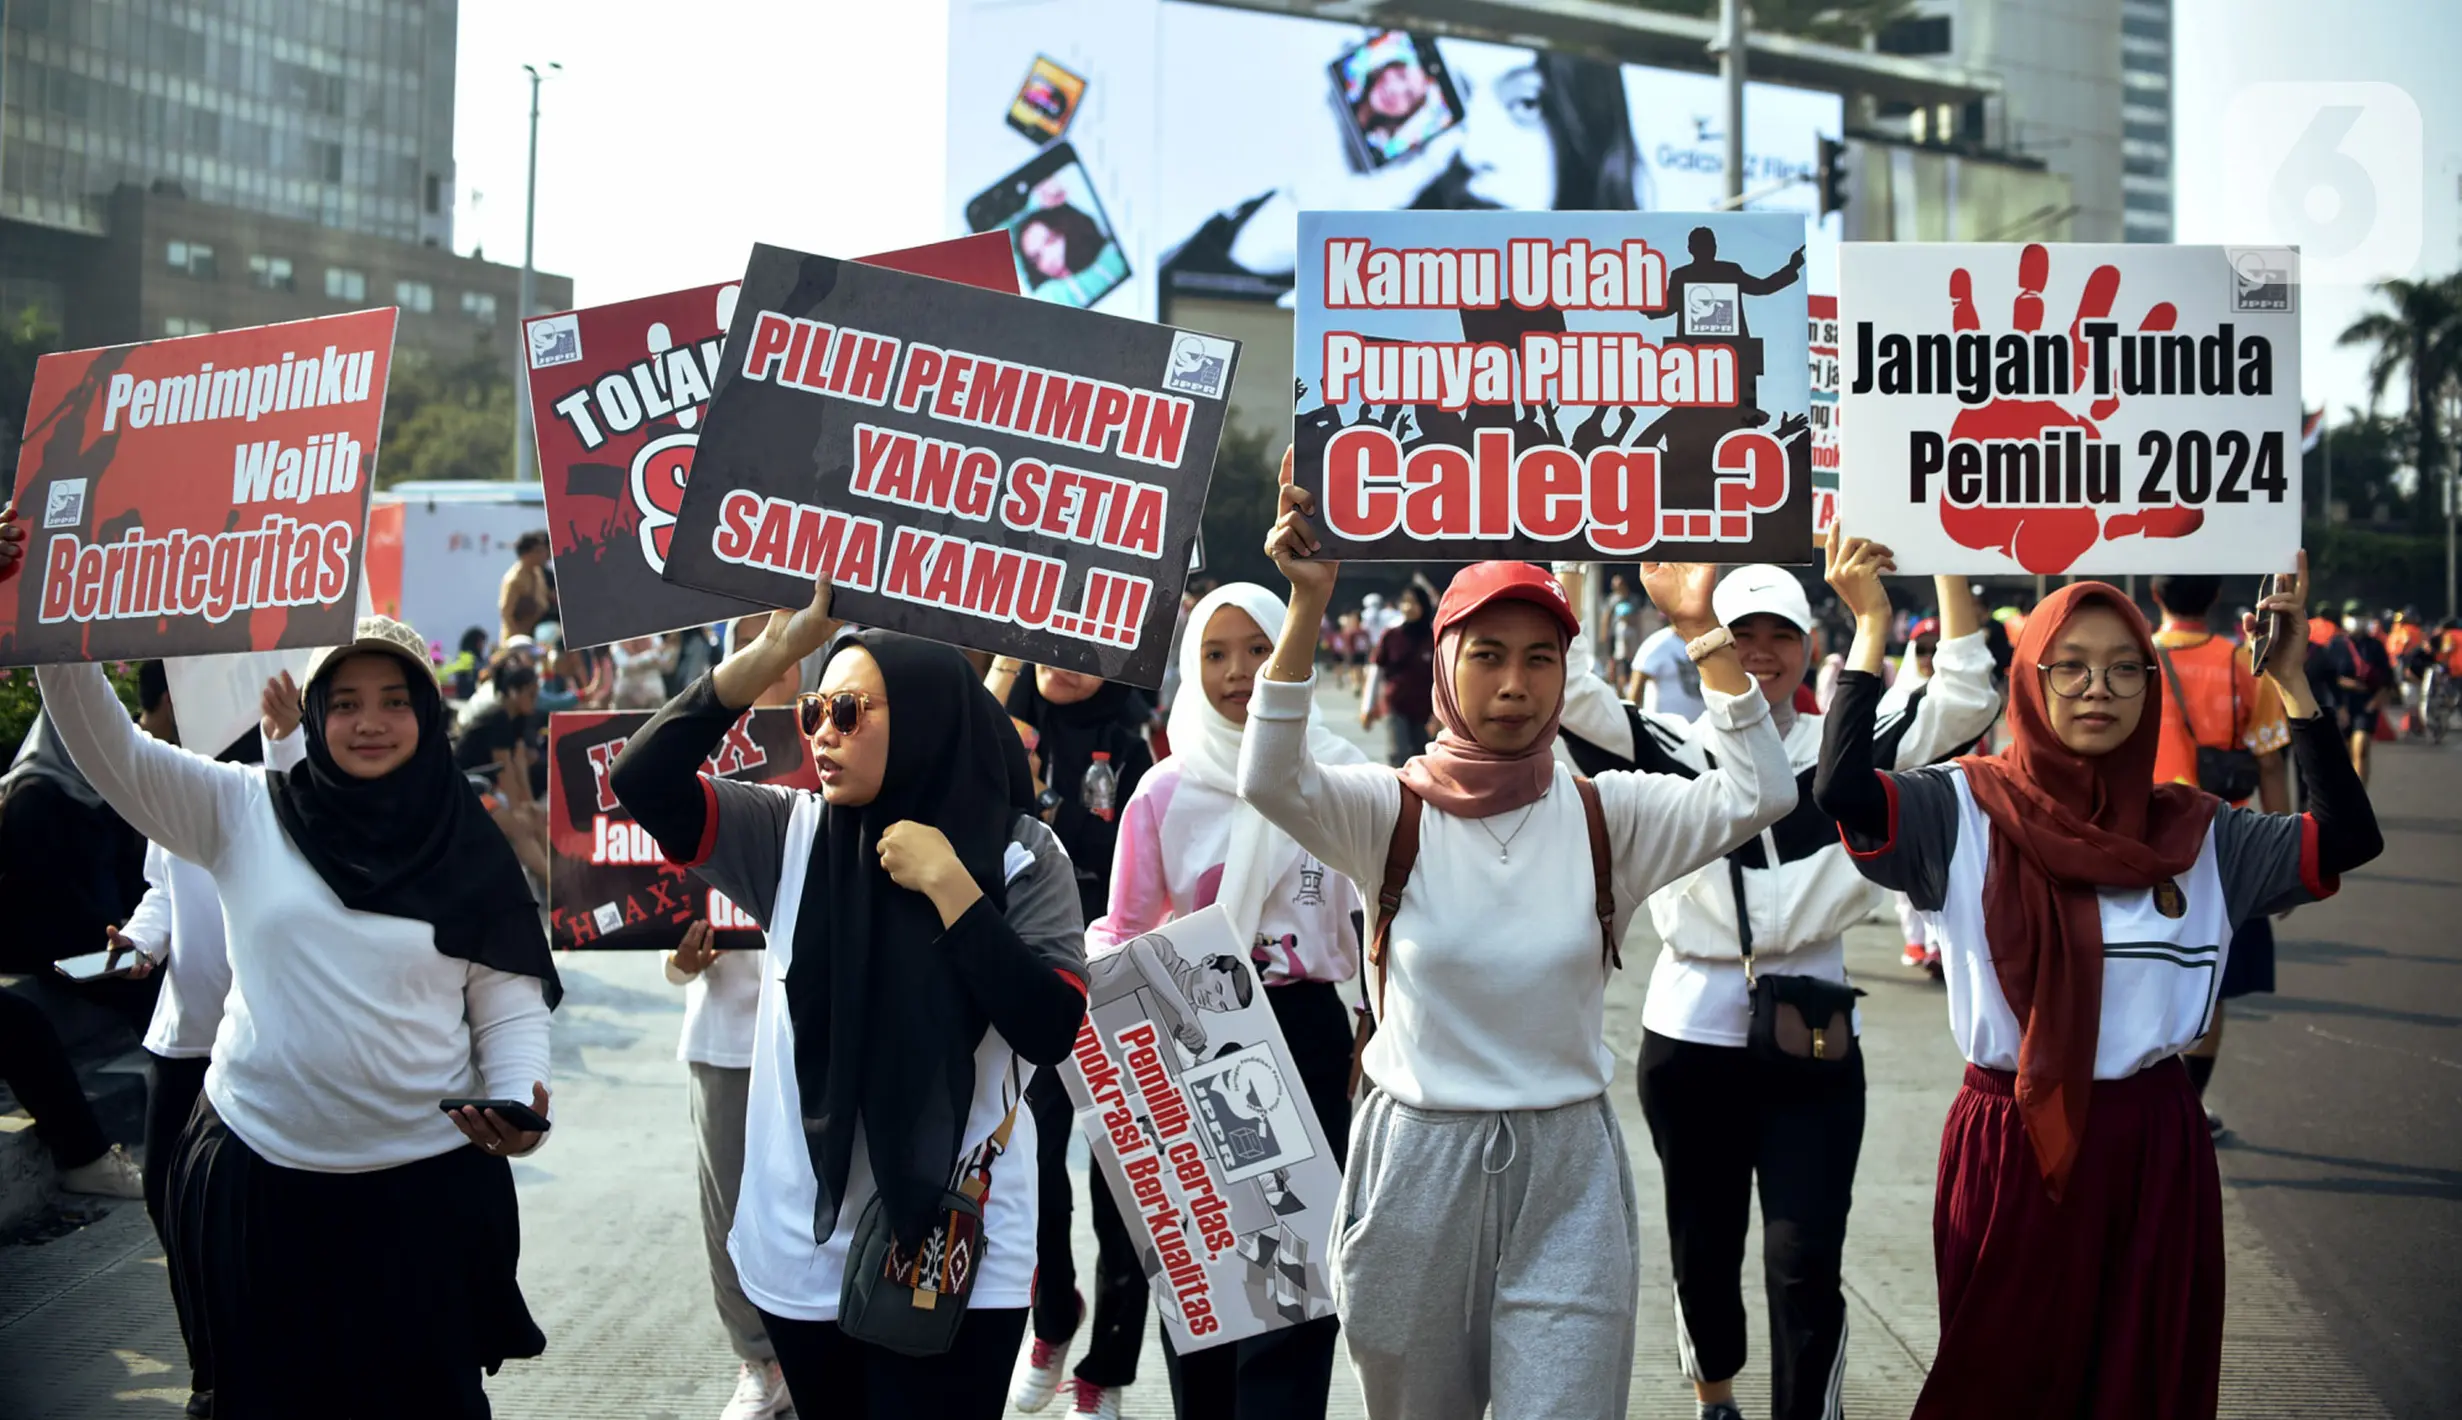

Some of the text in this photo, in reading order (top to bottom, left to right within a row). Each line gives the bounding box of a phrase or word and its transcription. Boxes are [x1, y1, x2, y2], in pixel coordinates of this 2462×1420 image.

[1325, 239, 1666, 309] Kamu Udah
[2239, 300, 2286, 309] JPPR
[1692, 324, 1732, 332] JPPR
[1852, 322, 2272, 404] Jangan Tunda
[102, 345, 375, 432] Pemimpinku
[744, 312, 1192, 468] PILIH PEMIMPIN
[1171, 379, 1216, 394] JPPR
[1325, 332, 1738, 411] Punya Pilihan
[232, 432, 361, 504] Wajib
[850, 424, 1166, 558] YANG SETIA
[1324, 425, 1790, 554] Caleg..?
[1910, 431, 2287, 504] Pemilu 2024
[38, 514, 353, 624] Berintegritas
[714, 491, 883, 592] SAMA
[882, 526, 1153, 650] KAMU..!!!
[1118, 1023, 1236, 1262] Pemilih cerdas,
[1193, 1084, 1237, 1168] JPPR
[1124, 1154, 1219, 1337] Berkualitas
